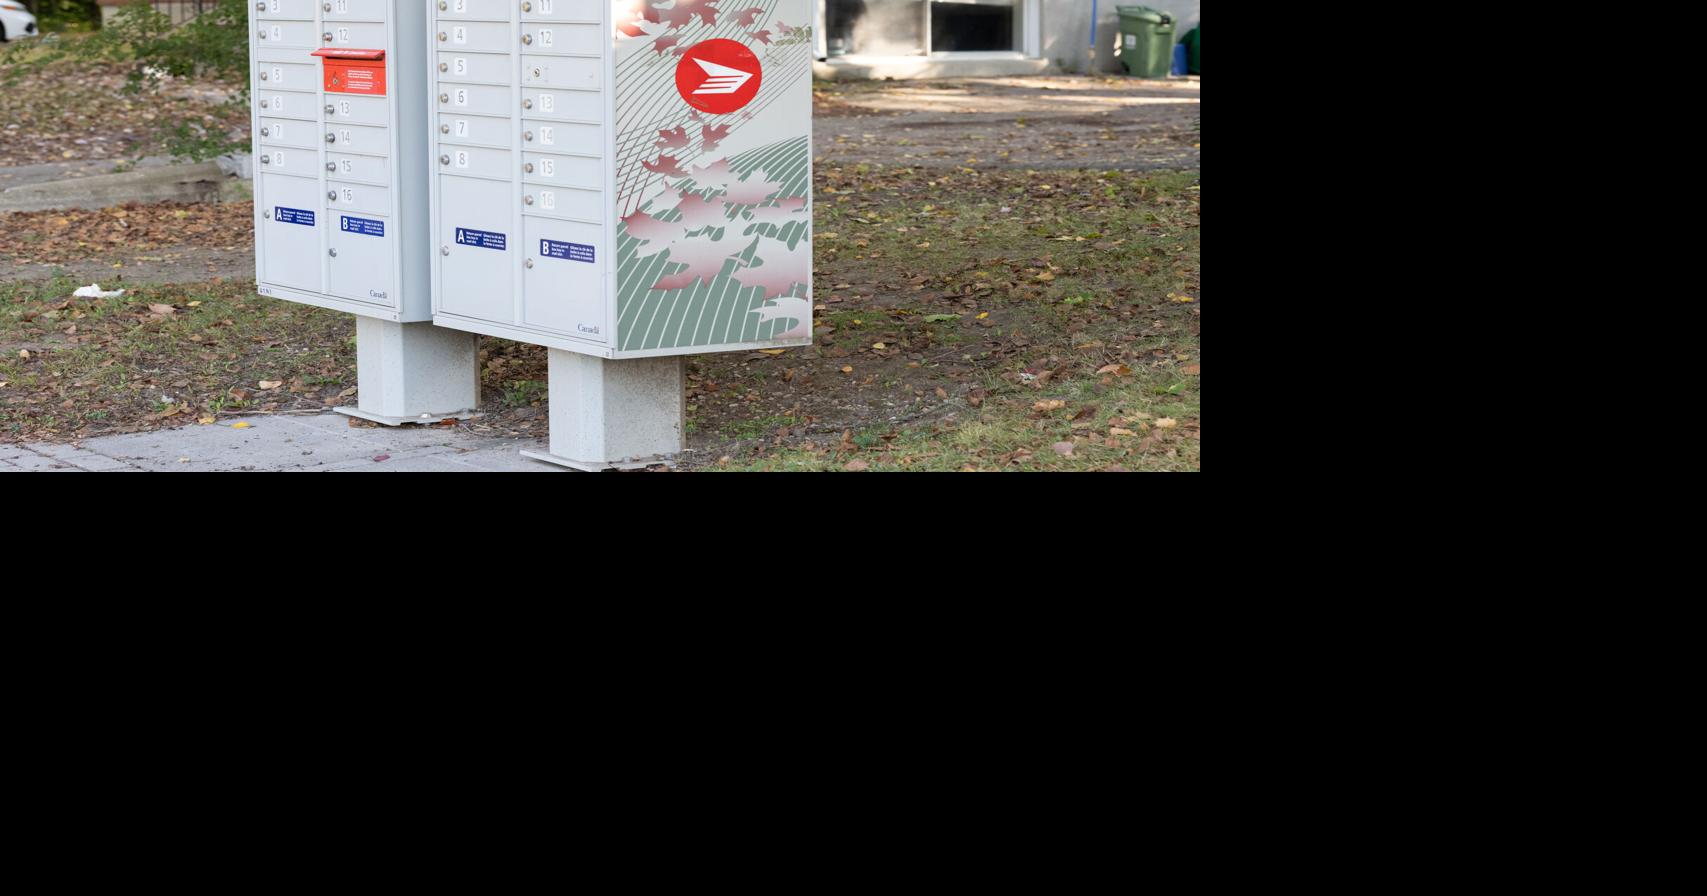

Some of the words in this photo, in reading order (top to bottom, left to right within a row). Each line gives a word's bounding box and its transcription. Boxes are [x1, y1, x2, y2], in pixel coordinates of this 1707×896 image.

[338, 0, 347, 11] 11
[541, 0, 551, 11] 11
[273, 26, 279, 37] 4
[339, 29, 348, 41] 12
[457, 29, 463, 41] 4
[541, 31, 552, 44] 12
[457, 60, 463, 72] 5
[275, 69, 280, 80] 5
[458, 91, 464, 103] 6
[542, 96, 553, 109] 13
[275, 98, 281, 109] 6
[340, 102, 350, 114] 13
[275, 125, 281, 136] 7
[458, 122, 464, 134] 7
[341, 131, 350, 143] 14
[542, 129, 553, 142] 14
[276, 153, 282, 164] 8
[459, 153, 465, 165] 8
[342, 160, 352, 172] 15
[542, 161, 553, 174] 15
[343, 189, 352, 201] 16
[542, 193, 553, 207] 16
[276, 208, 283, 221] A
[342, 217, 348, 230] B
[457, 229, 465, 243] A
[542, 241, 549, 255] B
[578, 323, 600, 334] Canada
